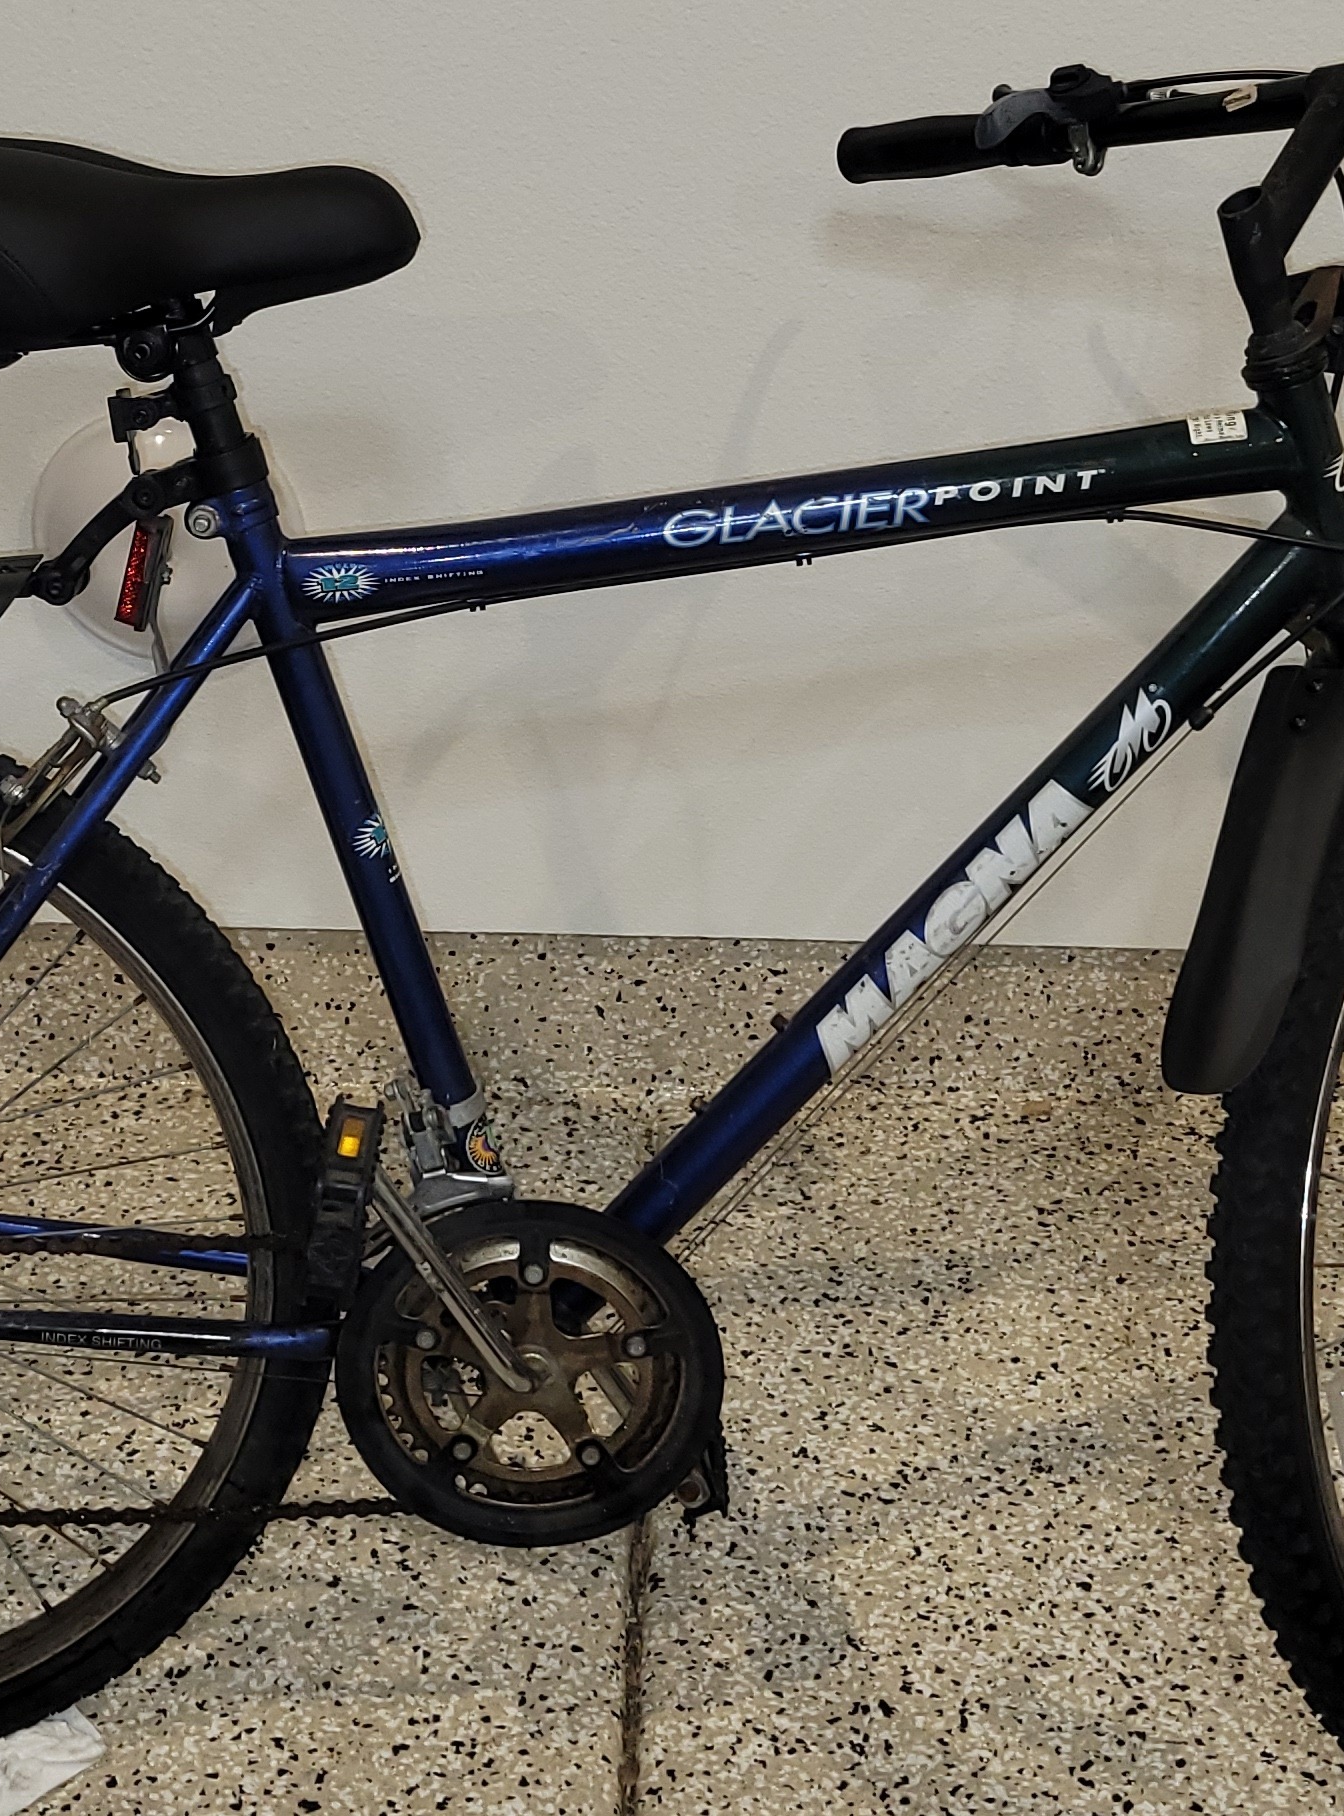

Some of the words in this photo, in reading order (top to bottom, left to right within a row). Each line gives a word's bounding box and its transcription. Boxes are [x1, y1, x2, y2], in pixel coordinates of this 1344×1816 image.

[662, 487, 930, 549] GLACIER
[934, 470, 1099, 506] POINT
[318, 574, 360, 592] 12
[384, 576, 420, 584] INDEX
[427, 570, 484, 580] SHIFTING
[816, 778, 1095, 1078] MAGNA
[41, 1332, 87, 1344] INDEX
[92, 1335, 163, 1350] SHIFTING
